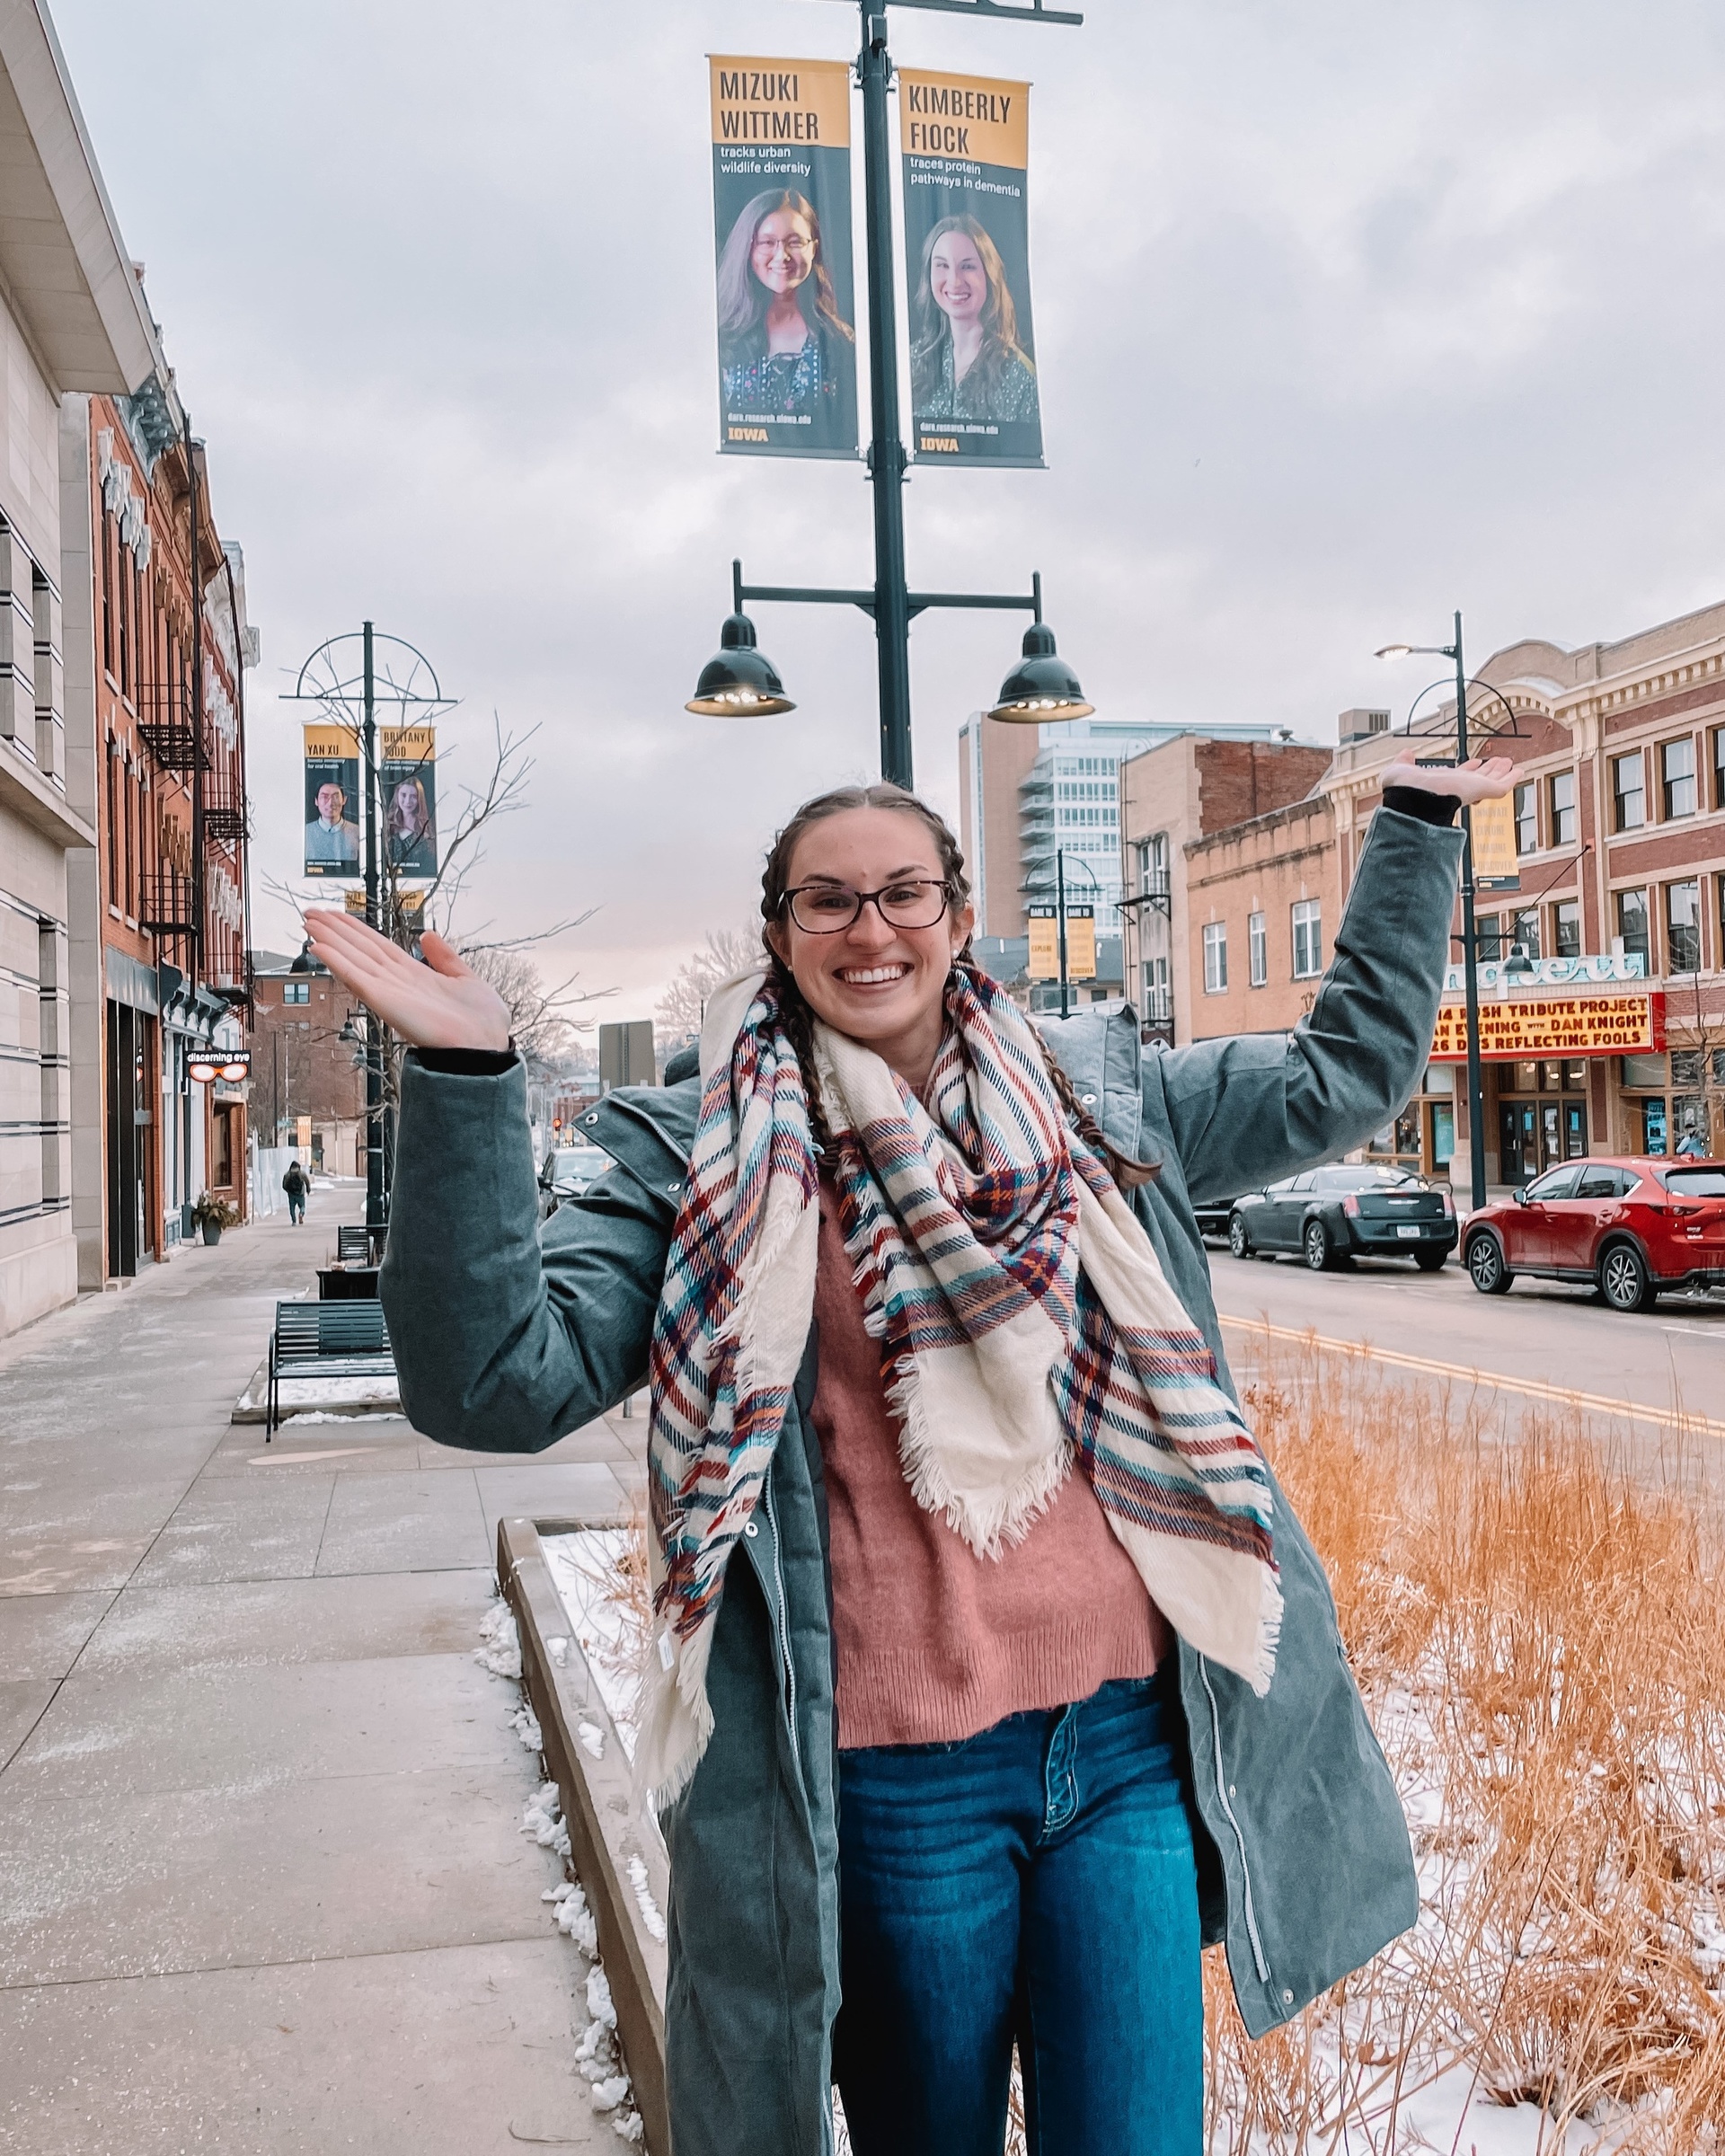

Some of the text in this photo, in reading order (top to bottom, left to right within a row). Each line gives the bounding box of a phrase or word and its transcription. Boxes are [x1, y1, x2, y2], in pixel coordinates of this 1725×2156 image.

[721, 71, 798, 102] MIZUKI
[909, 85, 1011, 124] KIMBERLY
[721, 110, 818, 139] WITTMER
[910, 122, 969, 155] FIOCK
[721, 146, 791, 158] tracks urban
[721, 162, 811, 177] wildlife diversity
[910, 157, 981, 175] traces protein
[911, 173, 1021, 198] pathways in dementia
[728, 427, 769, 442] IOWA
[920, 437, 960, 452] IOWA
[307, 744, 339, 755] YAN XU
[1475, 825, 1505, 836] EXPLORE
[1479, 861, 1513, 871] DISCOVER
[1443, 936, 1640, 1000] ngert
[1460, 1005, 1501, 1019] RSH
[1508, 1001, 1575, 1017] TRIBUTE
[1579, 998, 1647, 1013] PROJECT
[1455, 1021, 1520, 1035] EENING
[1551, 1018, 1583, 1031] DAN
[1588, 1014, 1647, 1029] KNIGHT
[1495, 1034, 1588, 1049] REFLECTING
[1593, 1031, 1641, 1046] FOOLS
[187, 1053, 250, 1064] discerning eye
